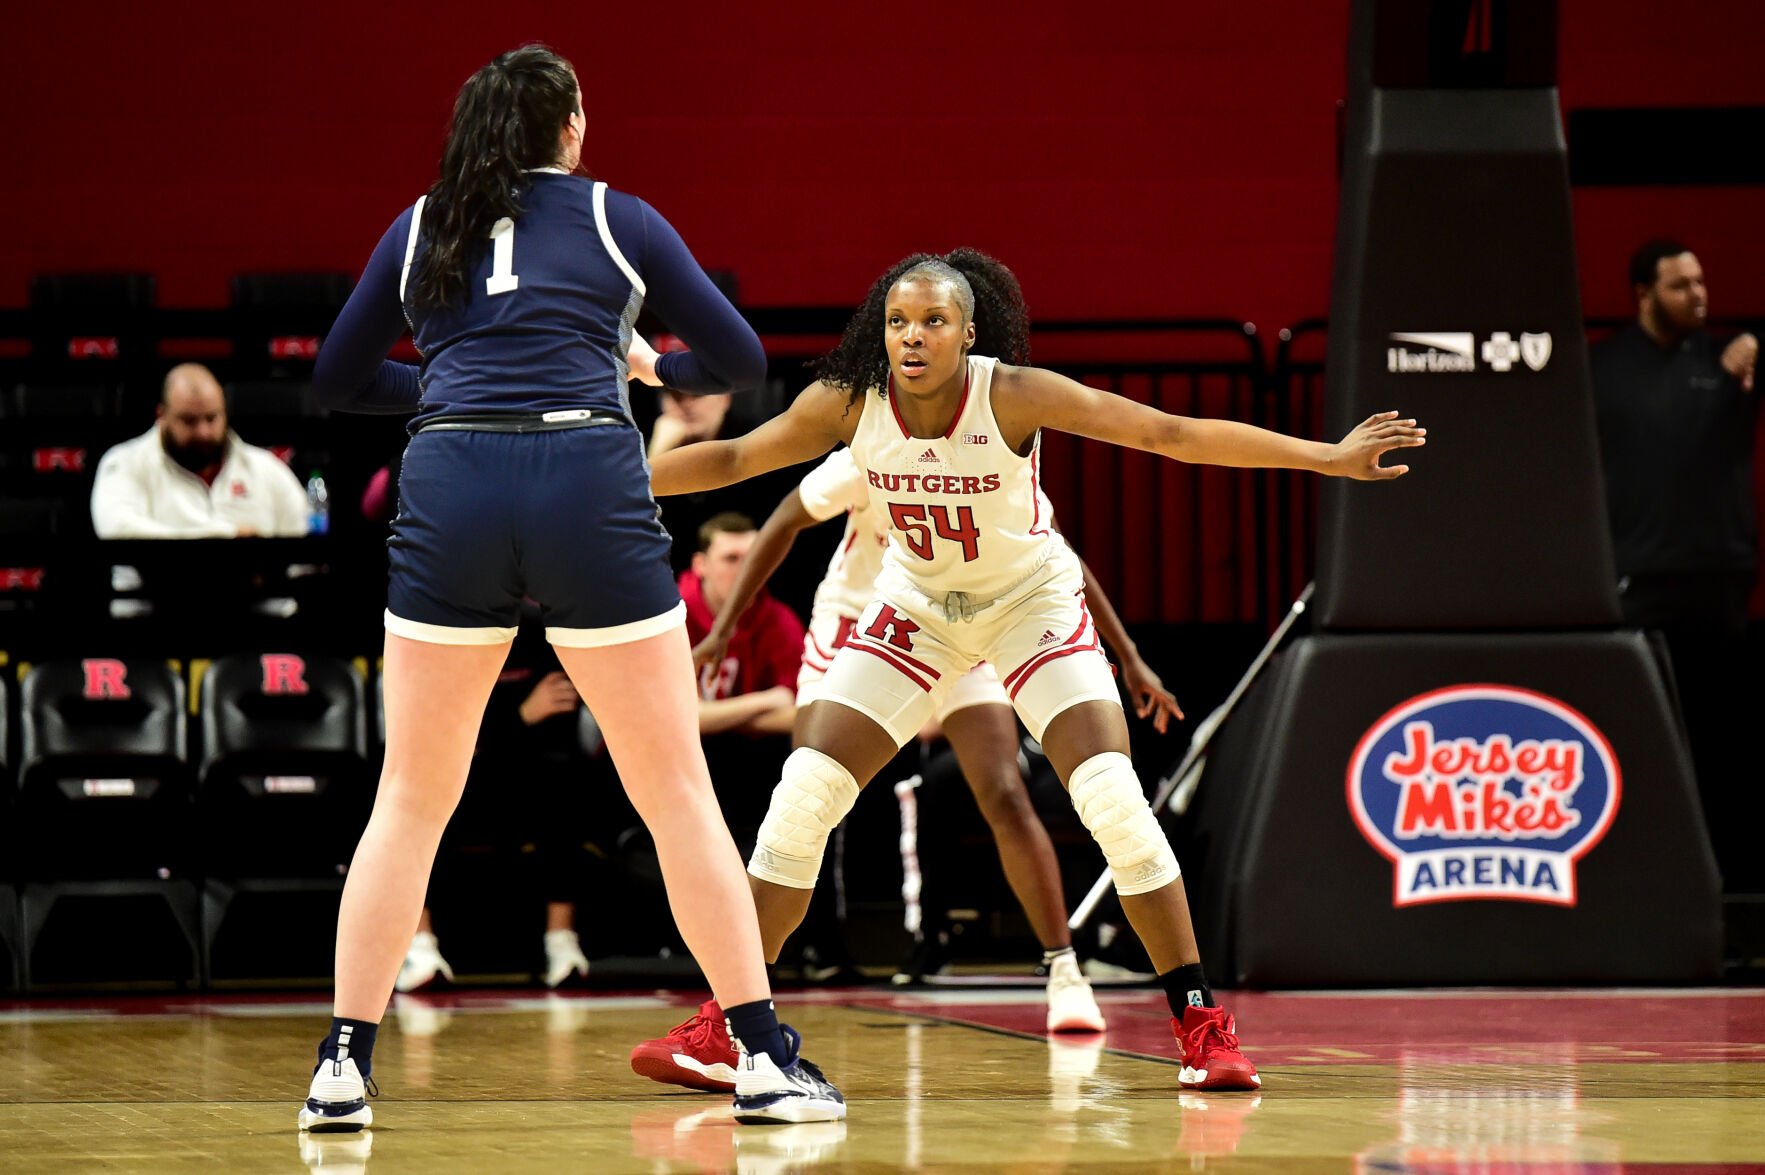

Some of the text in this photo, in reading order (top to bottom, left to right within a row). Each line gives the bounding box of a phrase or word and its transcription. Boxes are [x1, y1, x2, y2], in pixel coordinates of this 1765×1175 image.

[486, 217, 518, 295] 1
[867, 468, 1000, 494] RUTGERS
[887, 502, 980, 562] 54
[1037, 636, 1061, 647] adidas
[83, 658, 131, 699] R
[261, 654, 309, 694] R
[1388, 727, 1579, 793] Jersey
[1399, 782, 1576, 834] Mike's
[1135, 865, 1166, 882] adidas
[1411, 857, 1558, 892] ARENA
